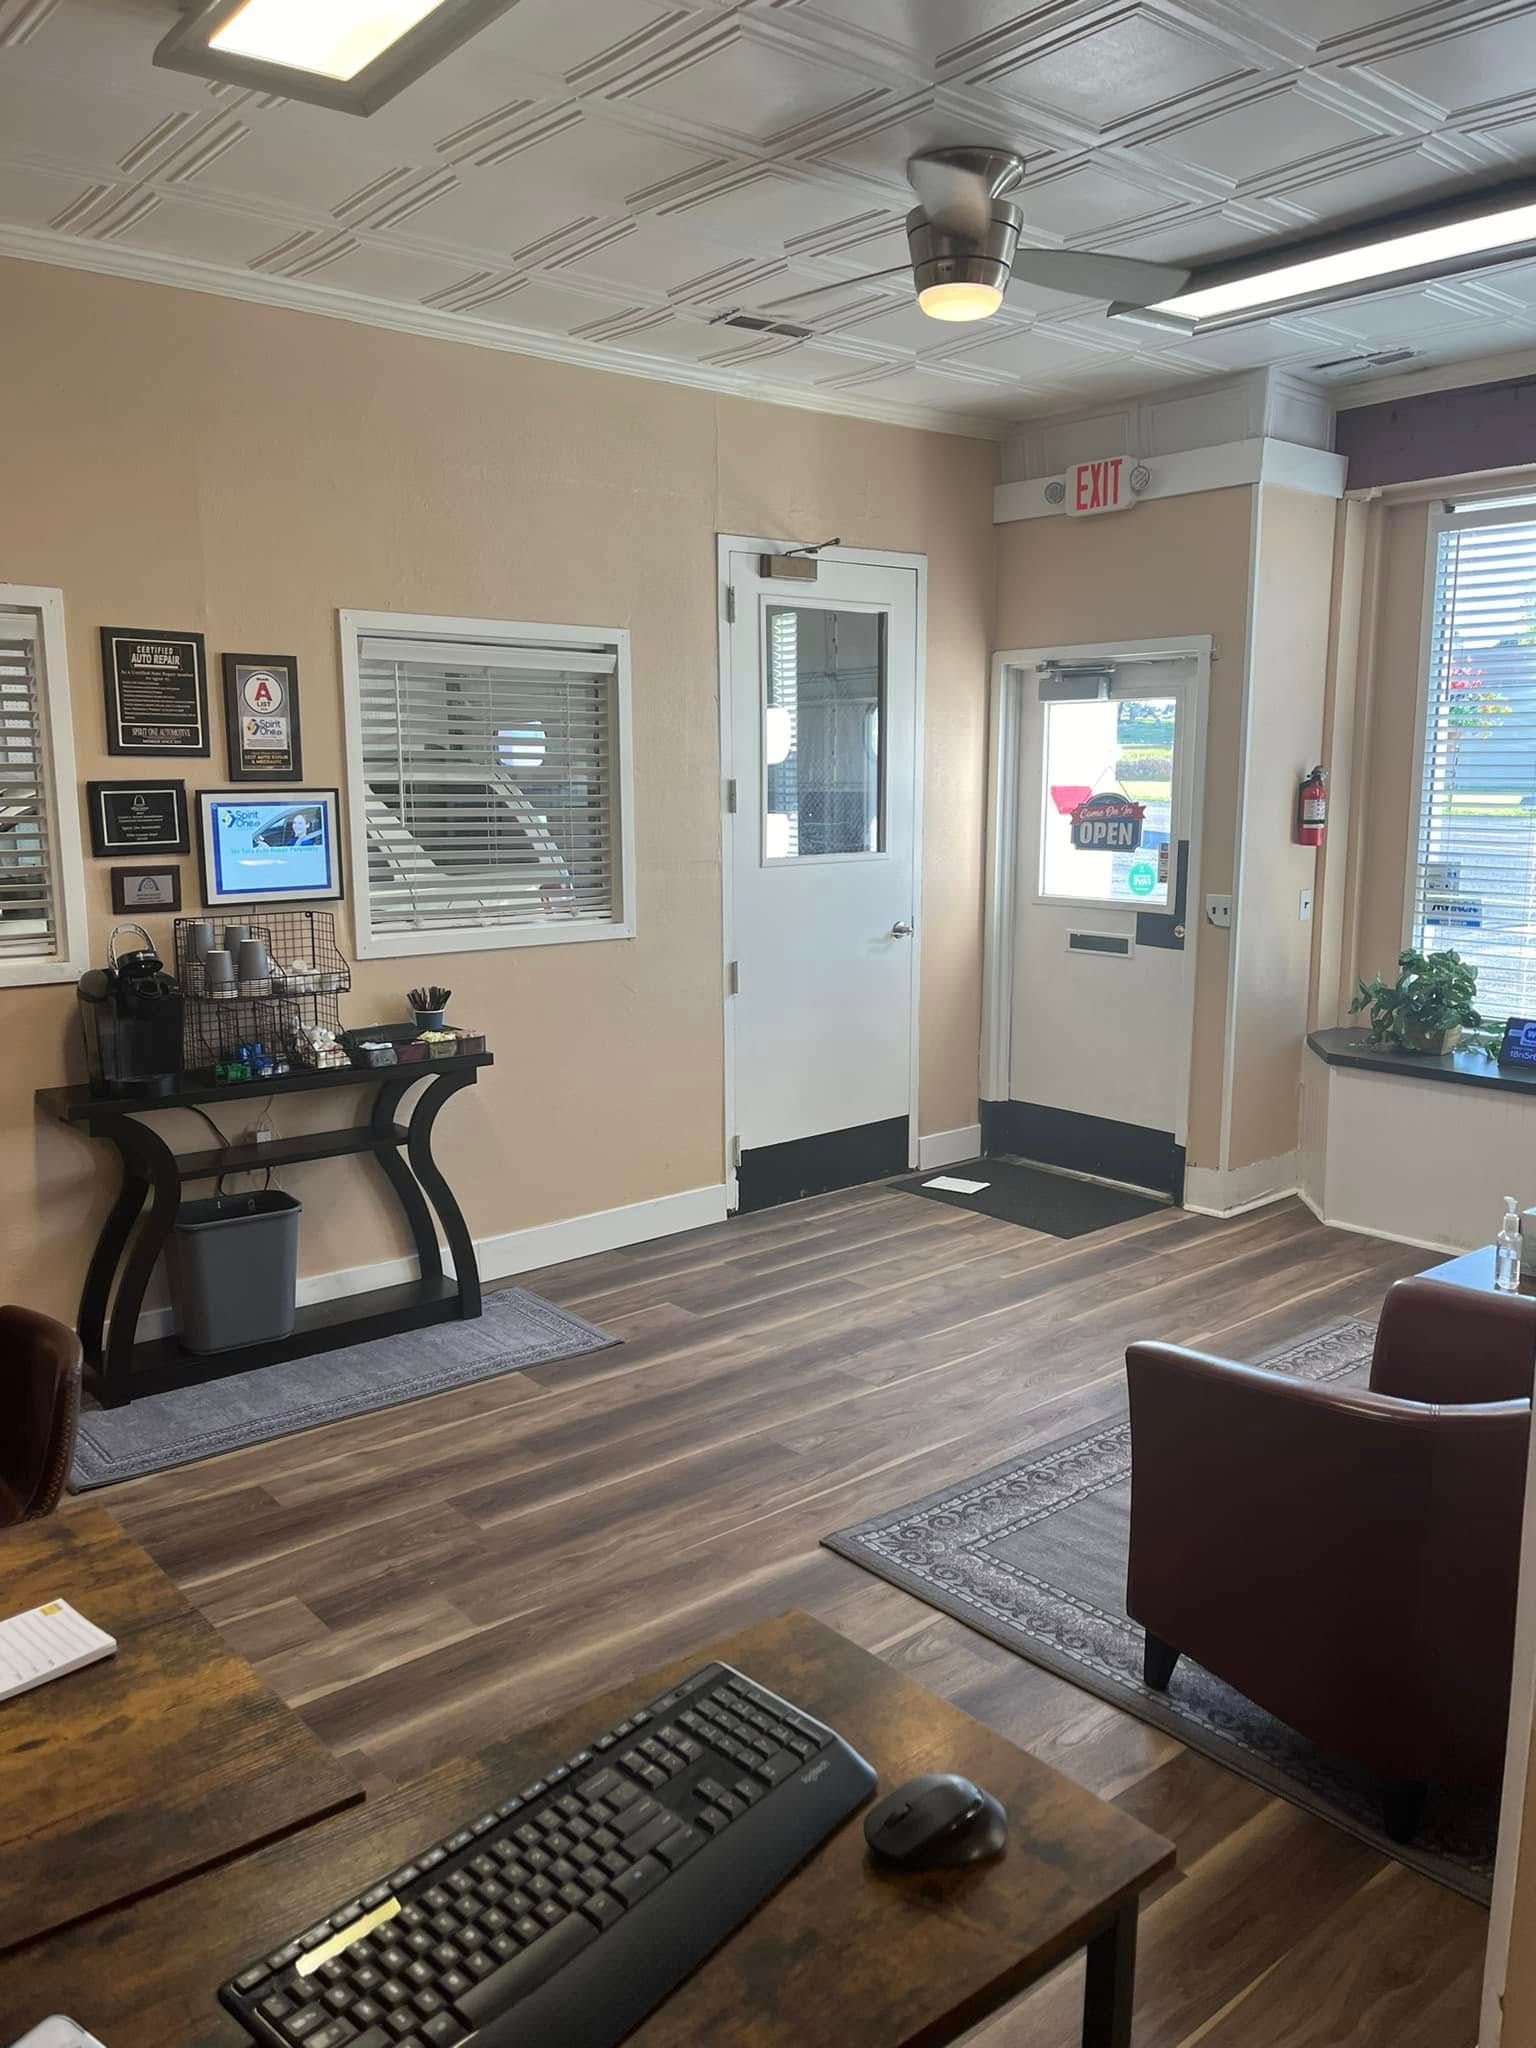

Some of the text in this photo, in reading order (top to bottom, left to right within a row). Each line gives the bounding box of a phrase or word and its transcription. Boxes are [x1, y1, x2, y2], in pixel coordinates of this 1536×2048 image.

[1076, 459, 1122, 510] EXIT
[136, 646, 173, 654] CERTIFIED
[131, 653, 180, 665] AUTO REPAIR
[255, 682, 272, 701] A
[259, 719, 281, 729] Spirit
[132, 727, 191, 737] SPIRIT ONE AUTOMOTIVE
[259, 727, 275, 735] One
[235, 810, 259, 820] Spirit
[1079, 806, 1133, 818] Come On In
[235, 819, 255, 827] One
[1080, 822, 1133, 845] OPEN
